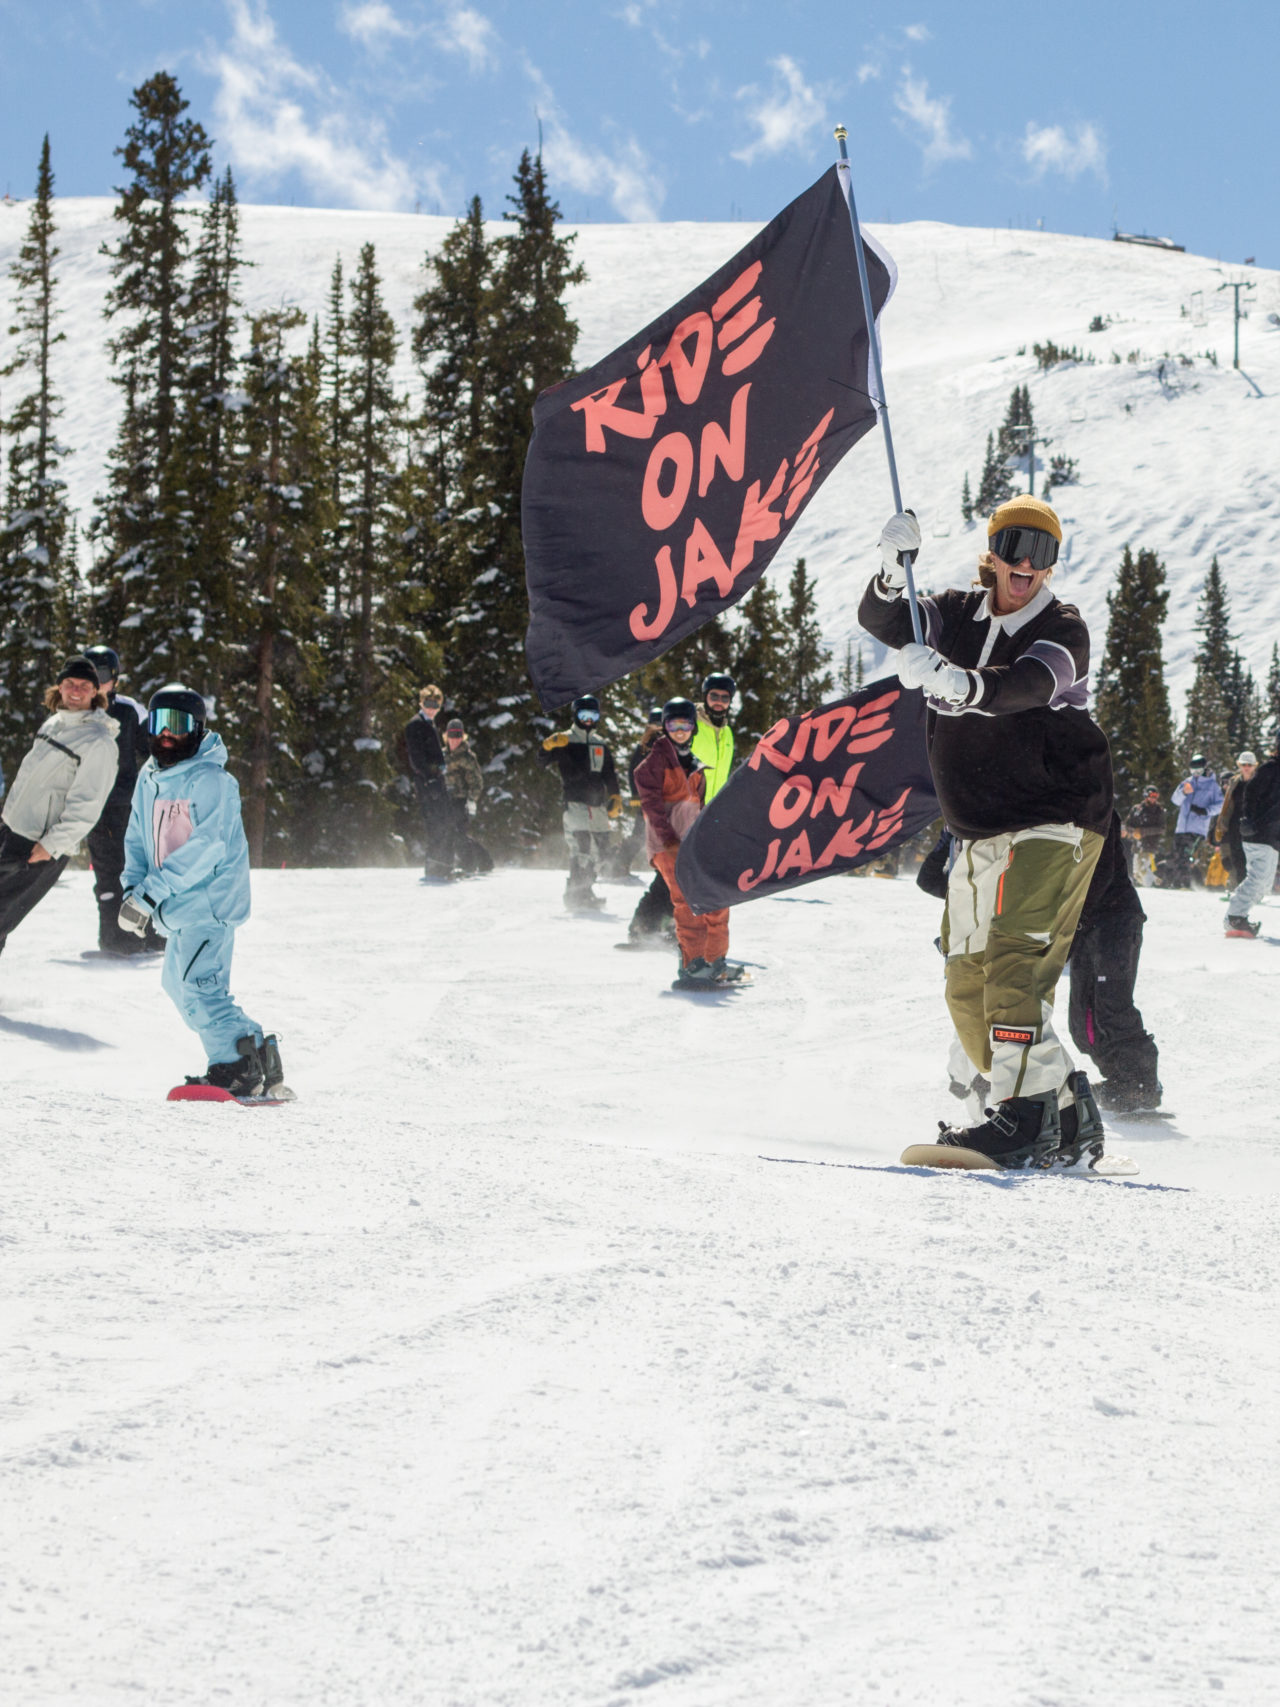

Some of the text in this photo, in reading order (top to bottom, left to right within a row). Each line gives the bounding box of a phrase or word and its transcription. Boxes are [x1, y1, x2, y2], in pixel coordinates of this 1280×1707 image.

[641, 382, 752, 531] ON
[629, 407, 835, 641] JAKE
[738, 787, 912, 892] JAKE
[769, 762, 866, 829] ON
